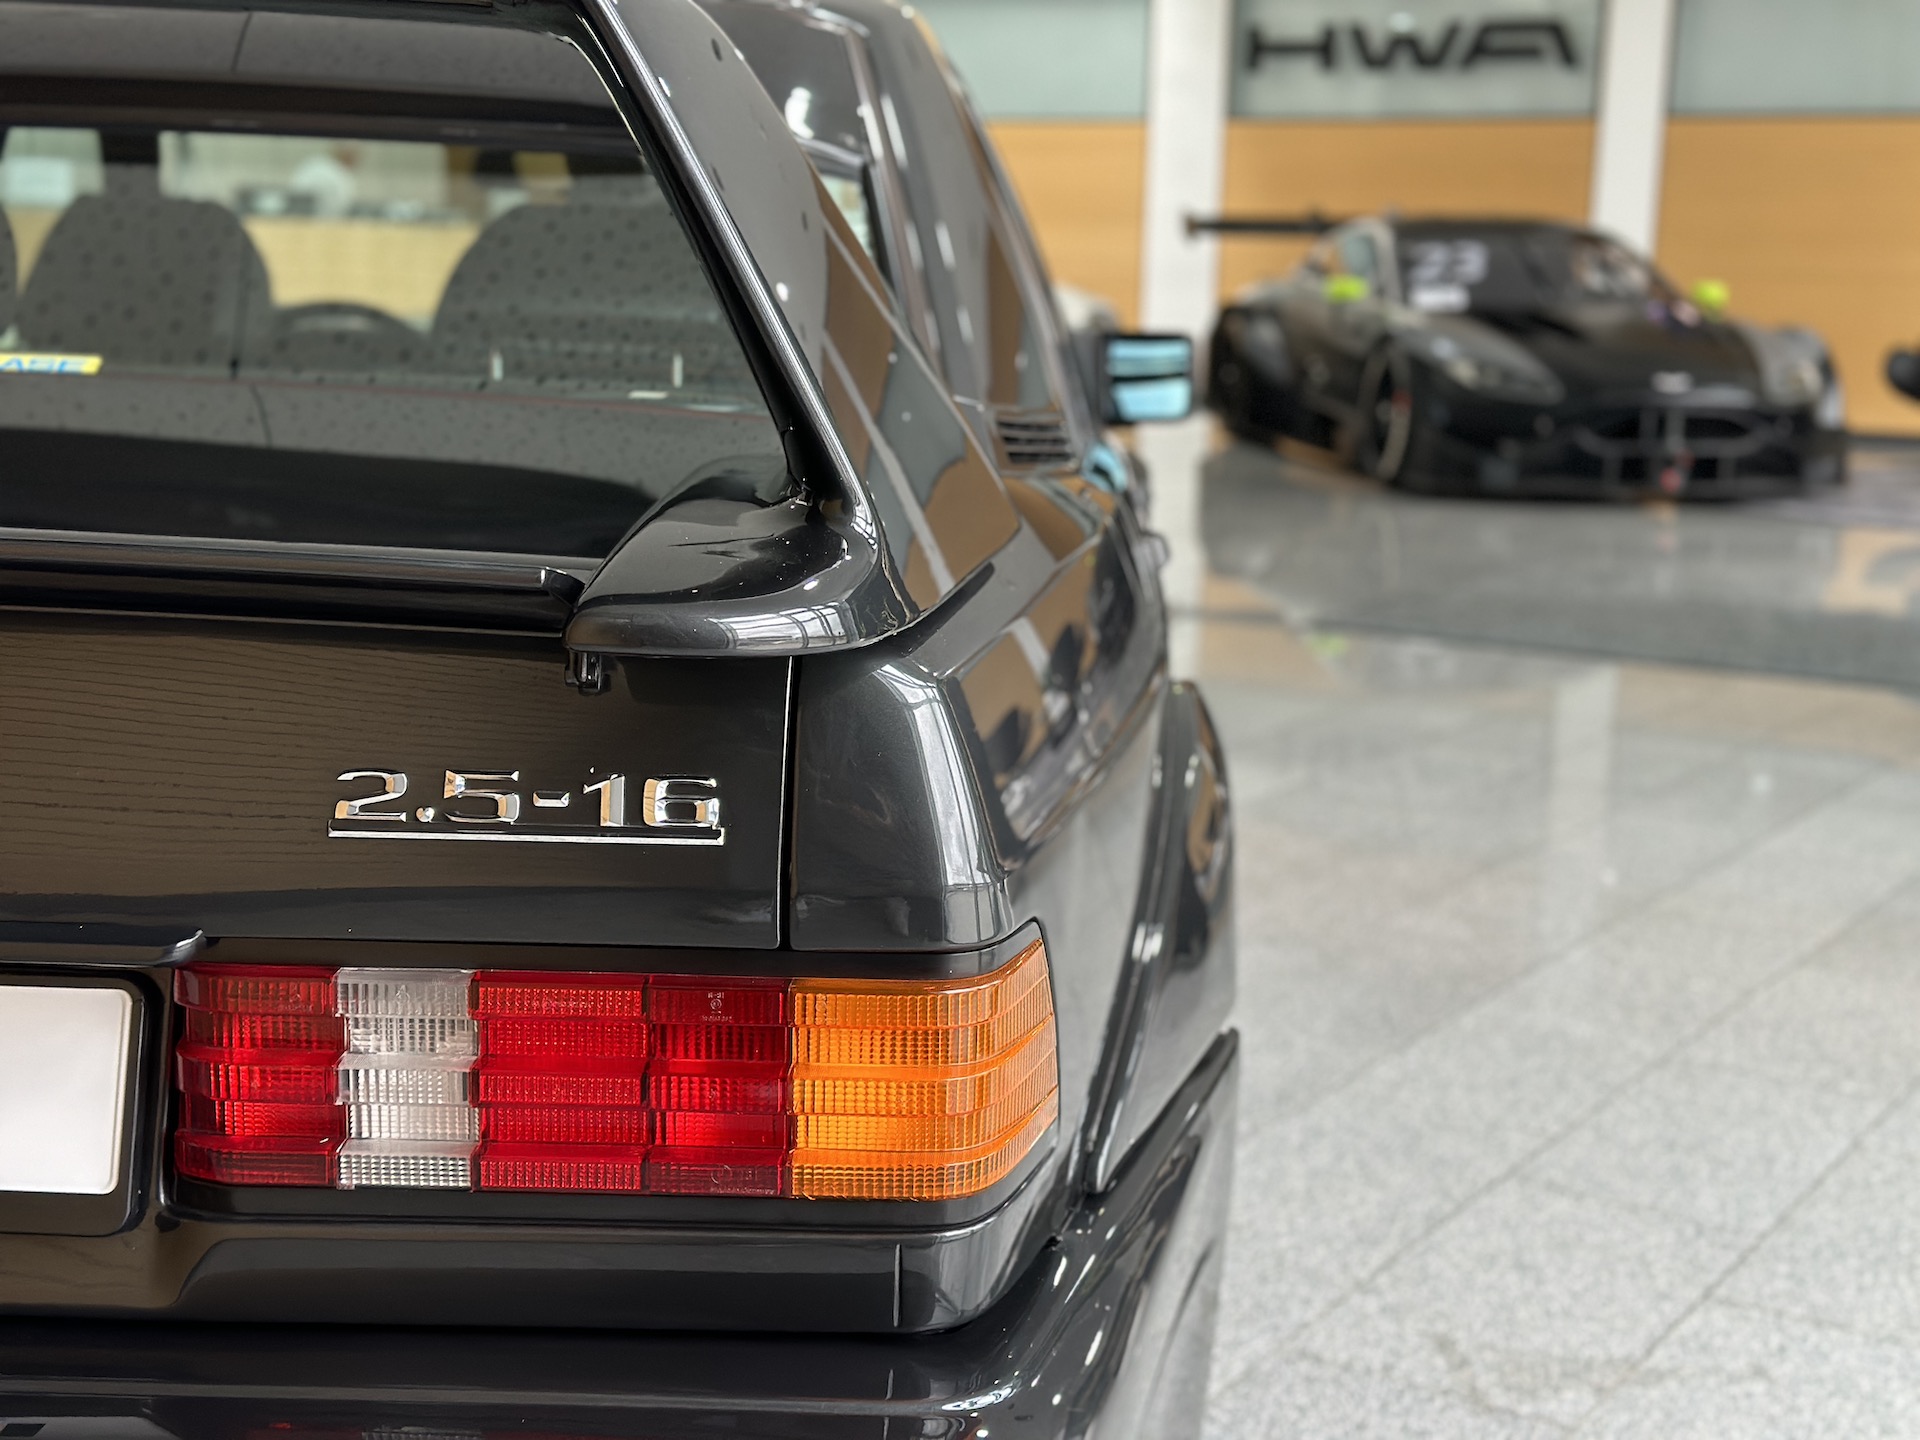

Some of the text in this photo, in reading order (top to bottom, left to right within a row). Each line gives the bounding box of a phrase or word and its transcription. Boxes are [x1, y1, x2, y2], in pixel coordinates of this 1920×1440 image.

[1246, 19, 1579, 71] HWA
[1409, 241, 1489, 284] 23
[334, 768, 720, 827] 2.5-16
